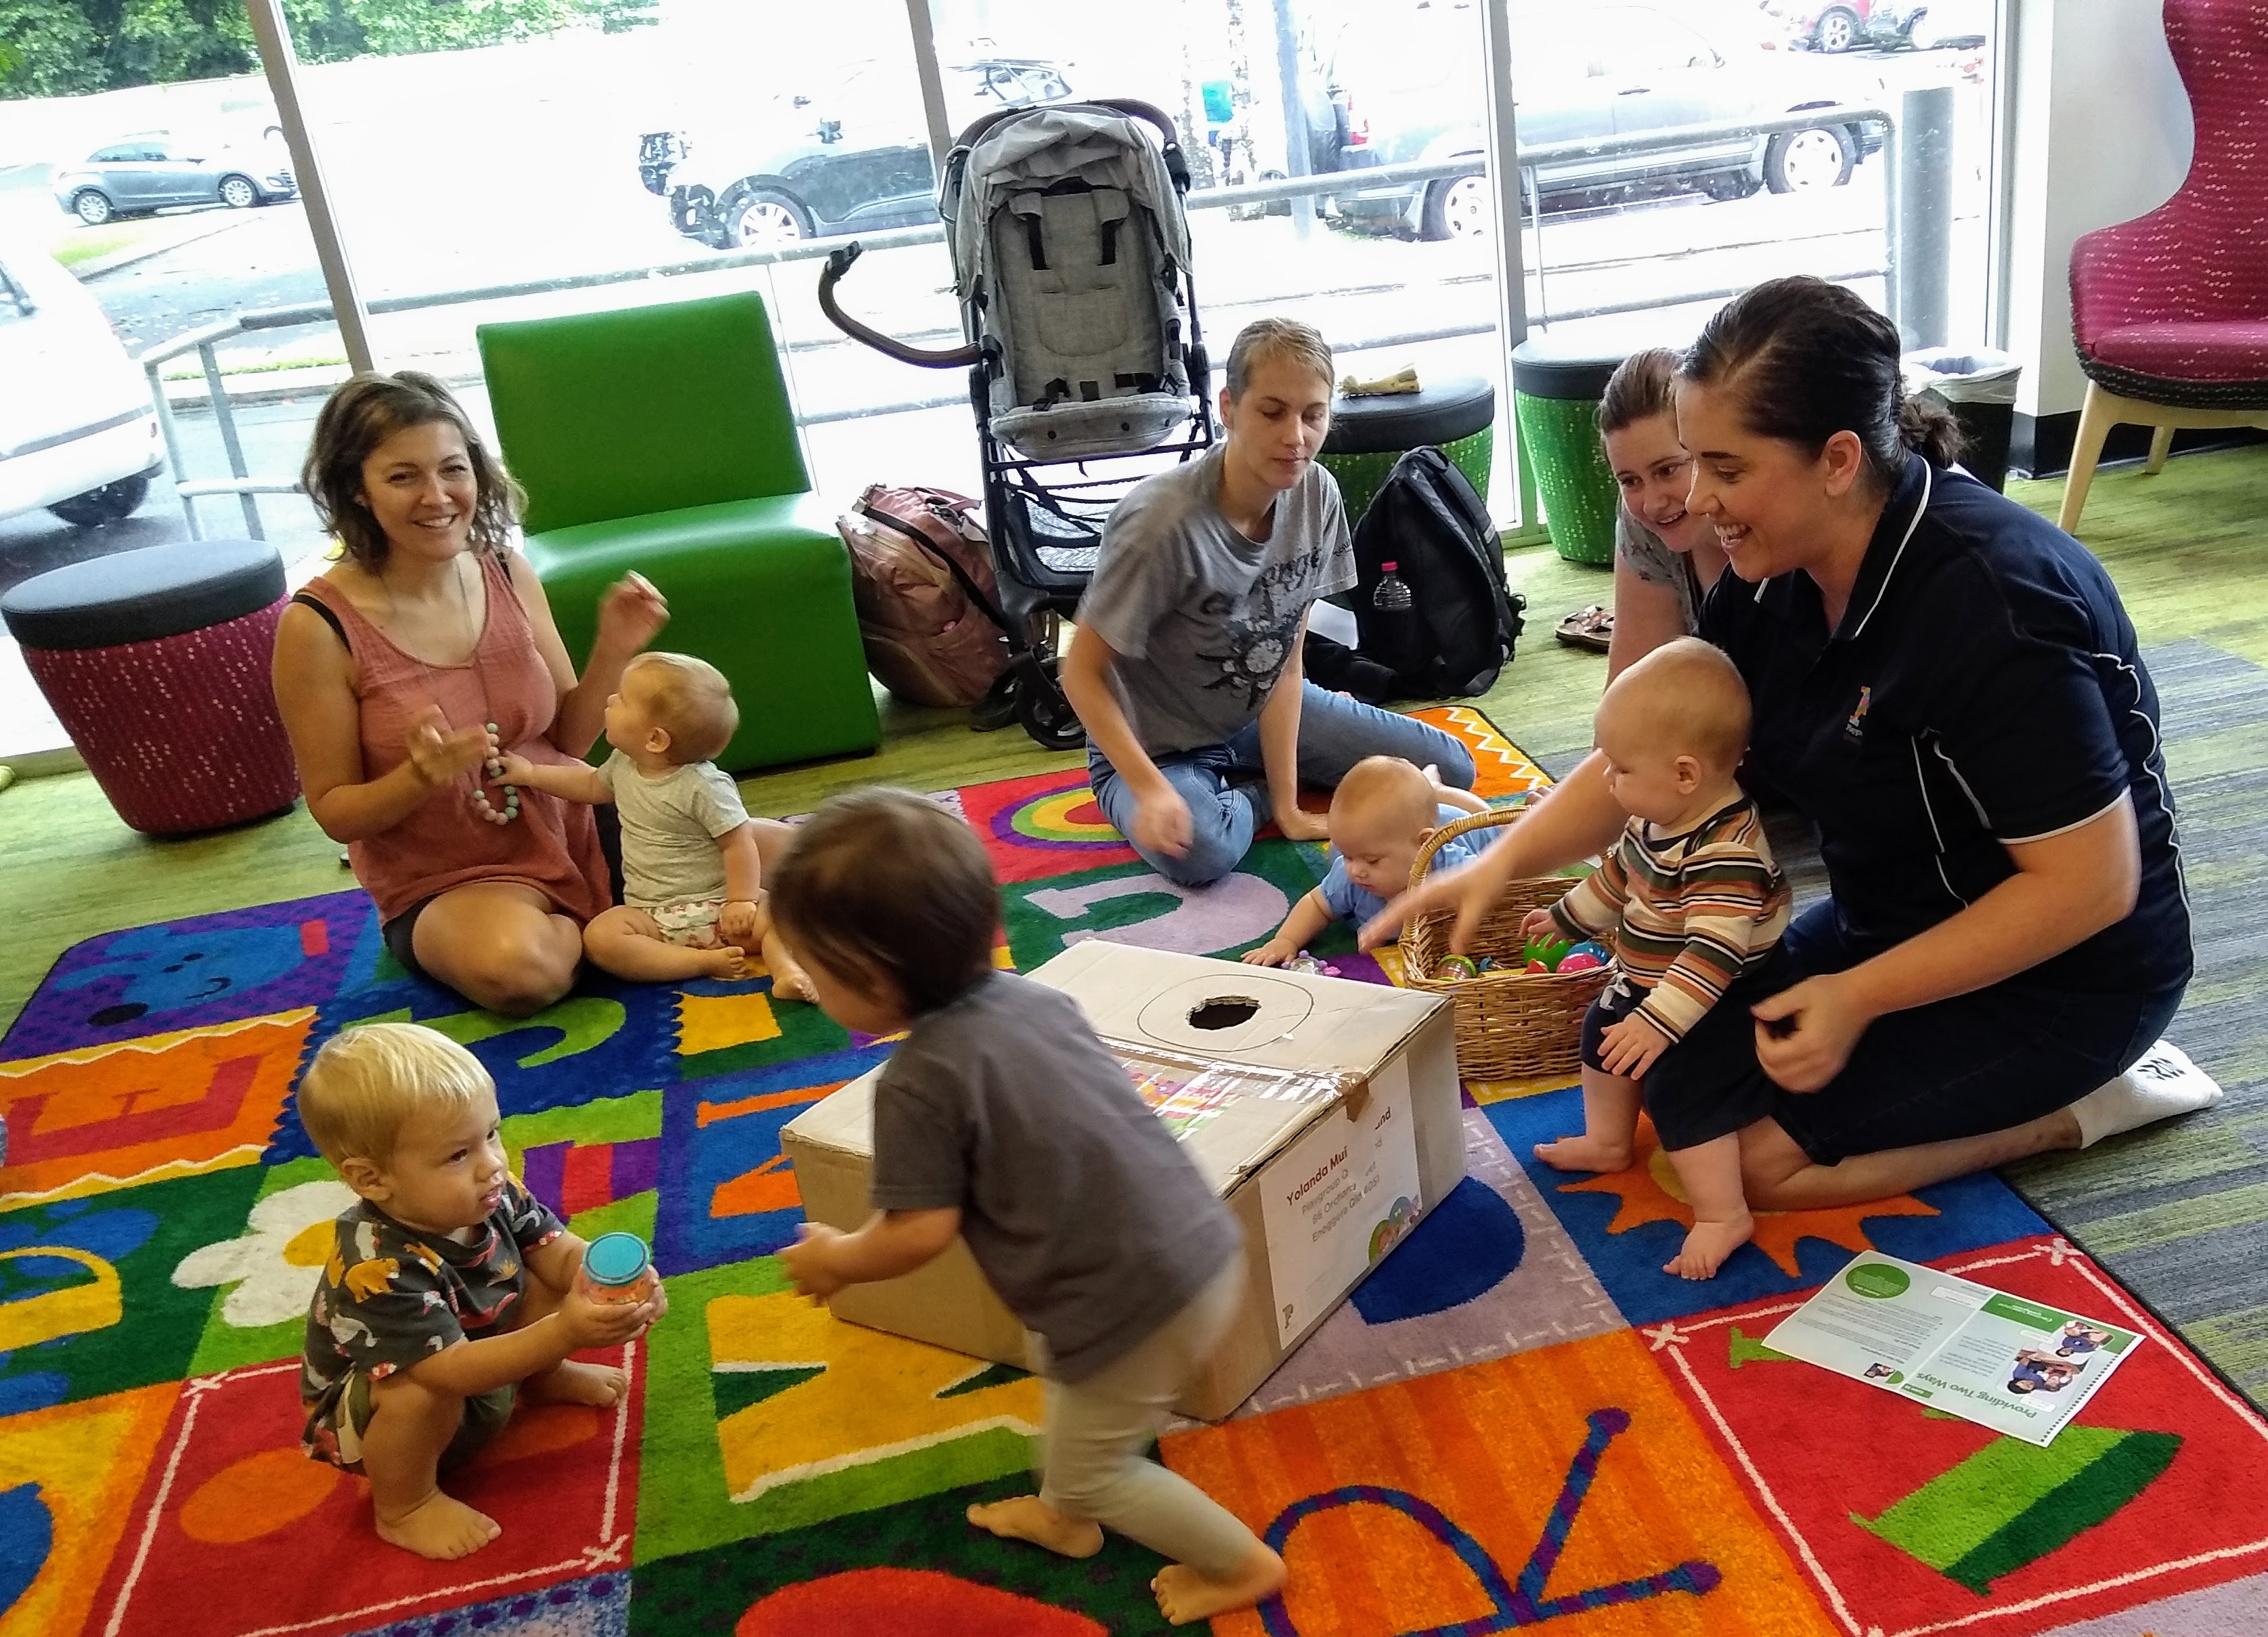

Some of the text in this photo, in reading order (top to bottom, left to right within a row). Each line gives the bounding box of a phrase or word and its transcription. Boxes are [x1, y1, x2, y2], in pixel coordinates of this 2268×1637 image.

[1286, 1164, 1329, 1206] Yolanda
[1302, 1177, 1340, 1216] Playgroup
[1312, 1206, 1349, 1243] Enoggera
[1916, 1372, 1948, 1389] Ways
[1950, 1384, 1975, 1399] Two
[1976, 1391, 2038, 1419] Providing
